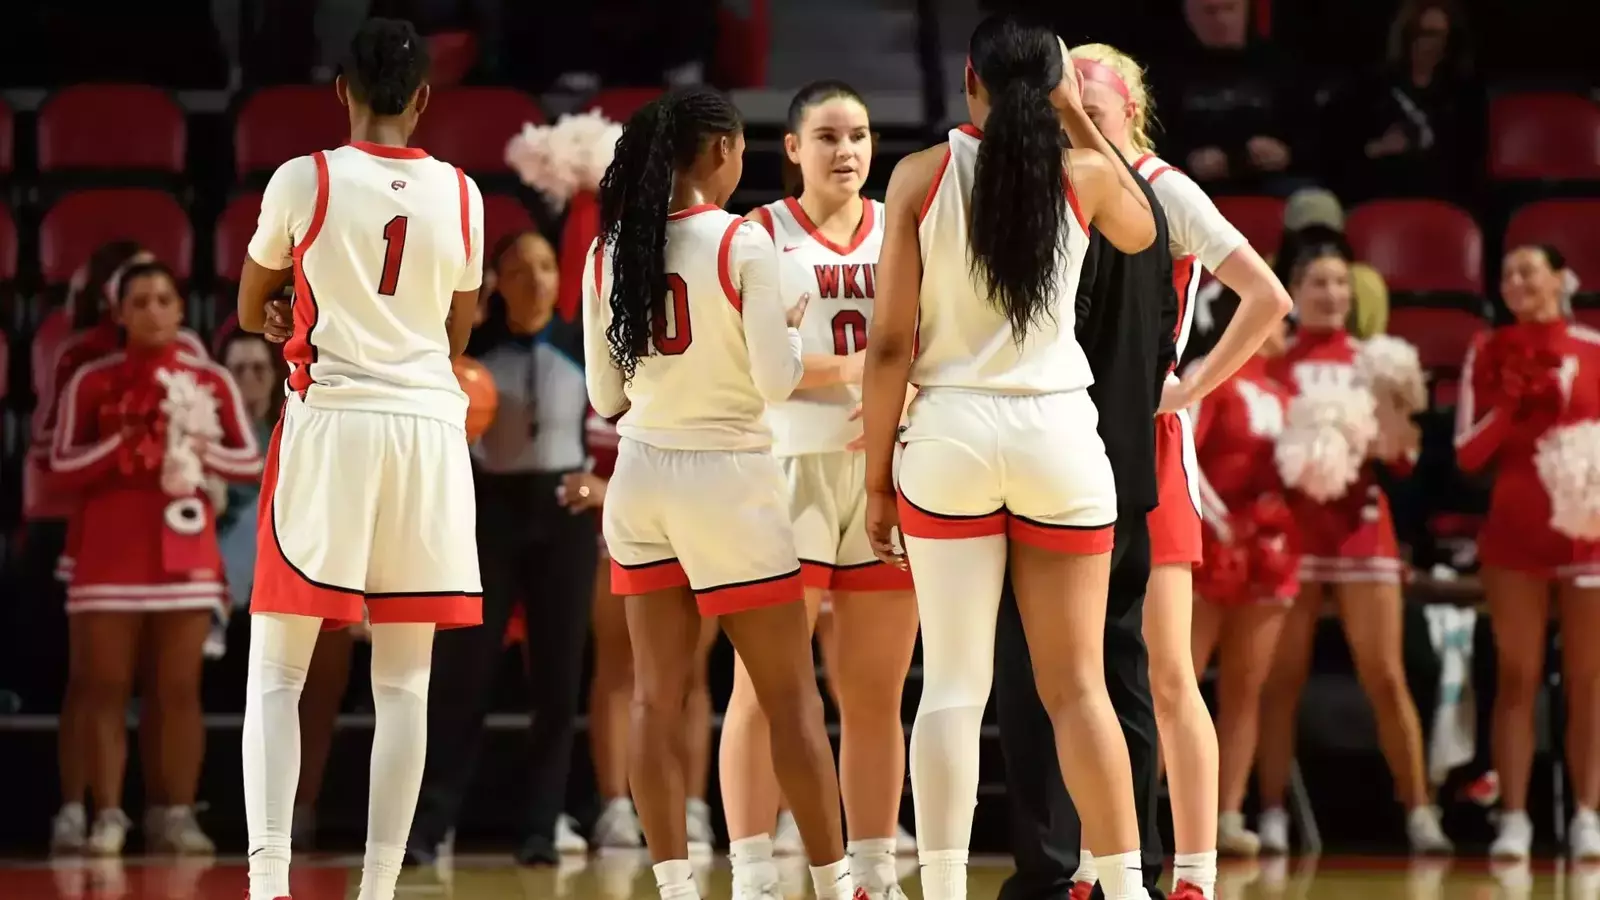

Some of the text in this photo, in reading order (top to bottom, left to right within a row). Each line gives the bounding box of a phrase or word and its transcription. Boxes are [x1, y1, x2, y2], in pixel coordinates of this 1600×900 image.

[378, 215, 408, 296] 1
[634, 272, 692, 356] 0
[831, 309, 868, 356] 0
